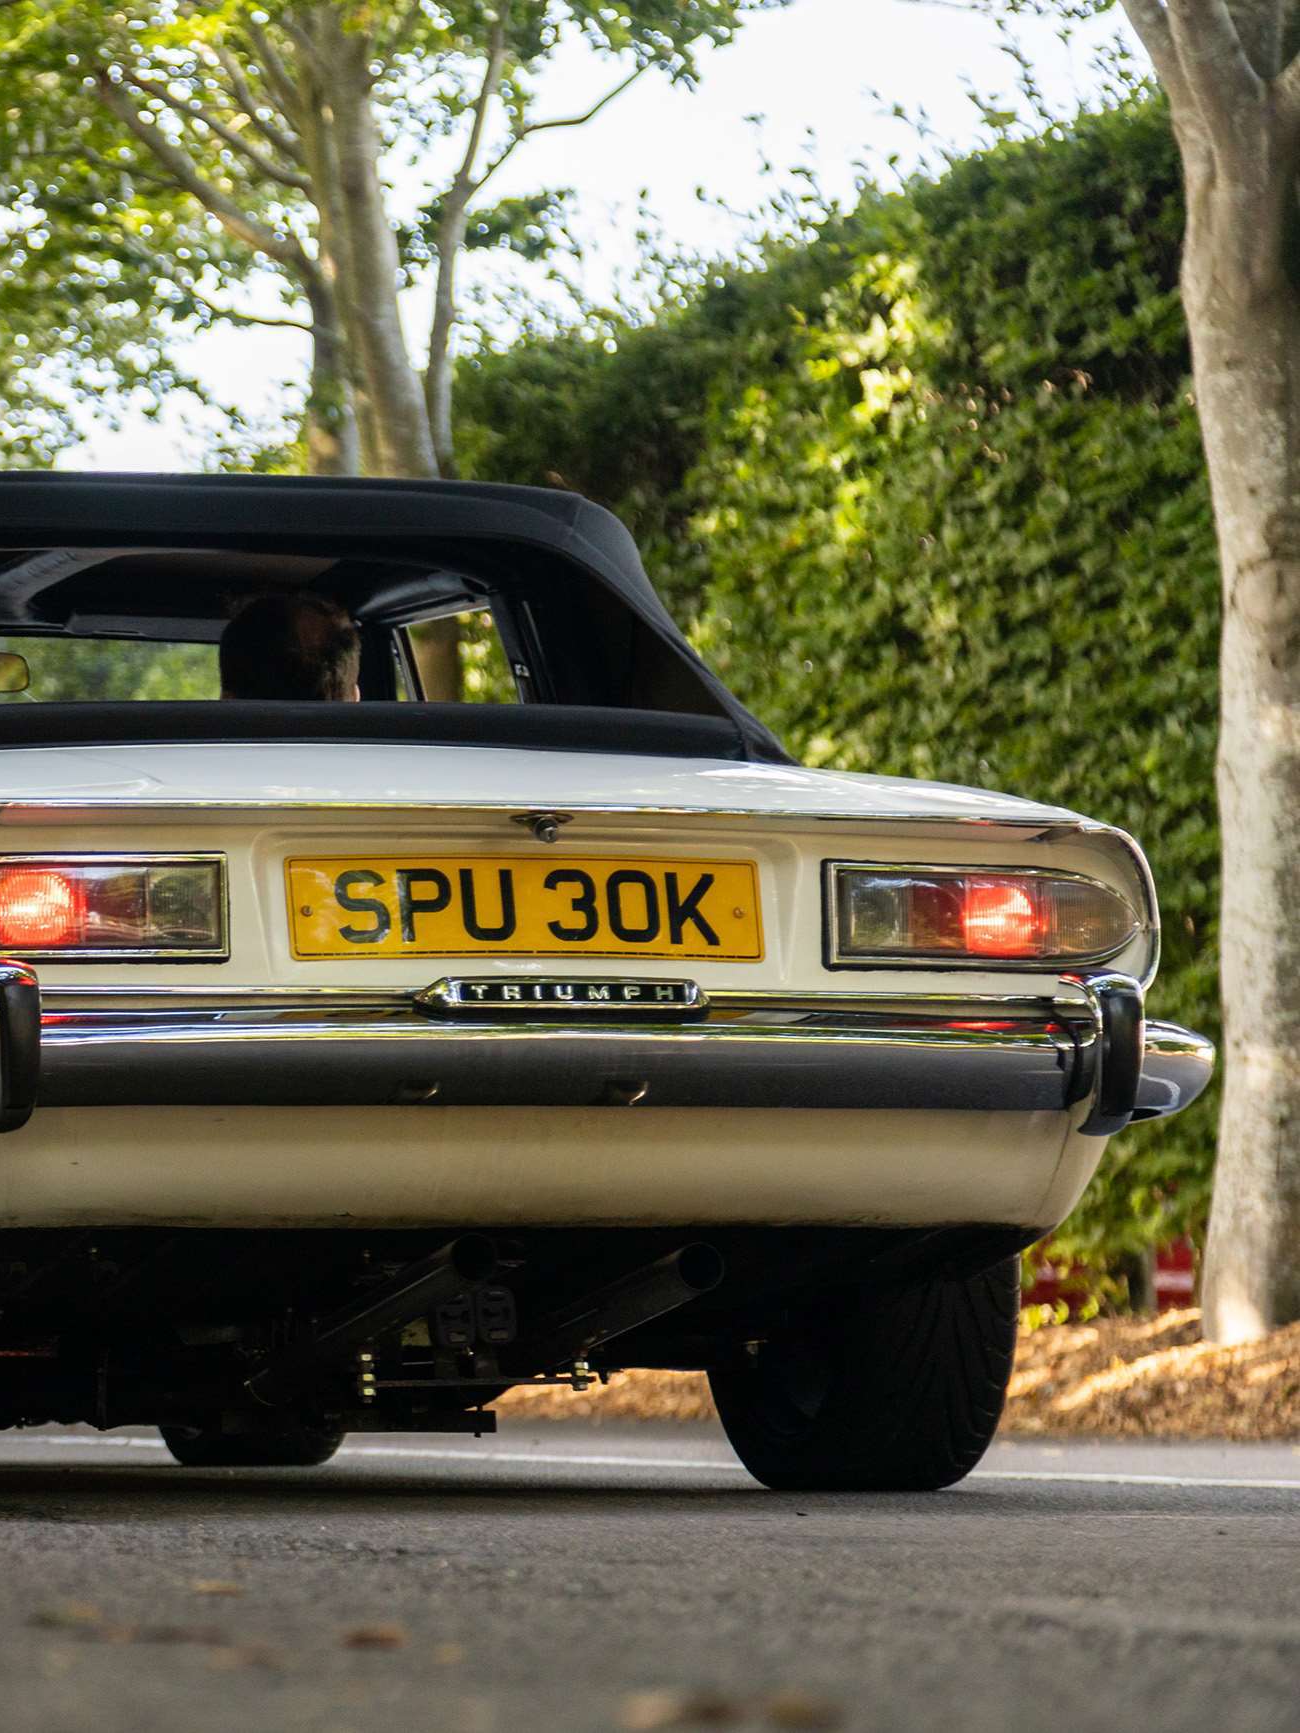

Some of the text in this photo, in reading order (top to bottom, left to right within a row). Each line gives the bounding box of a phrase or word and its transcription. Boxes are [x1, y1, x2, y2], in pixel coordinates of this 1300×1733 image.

[334, 868, 721, 946] SPU 30K
[470, 983, 675, 1001] TRIUMPH
